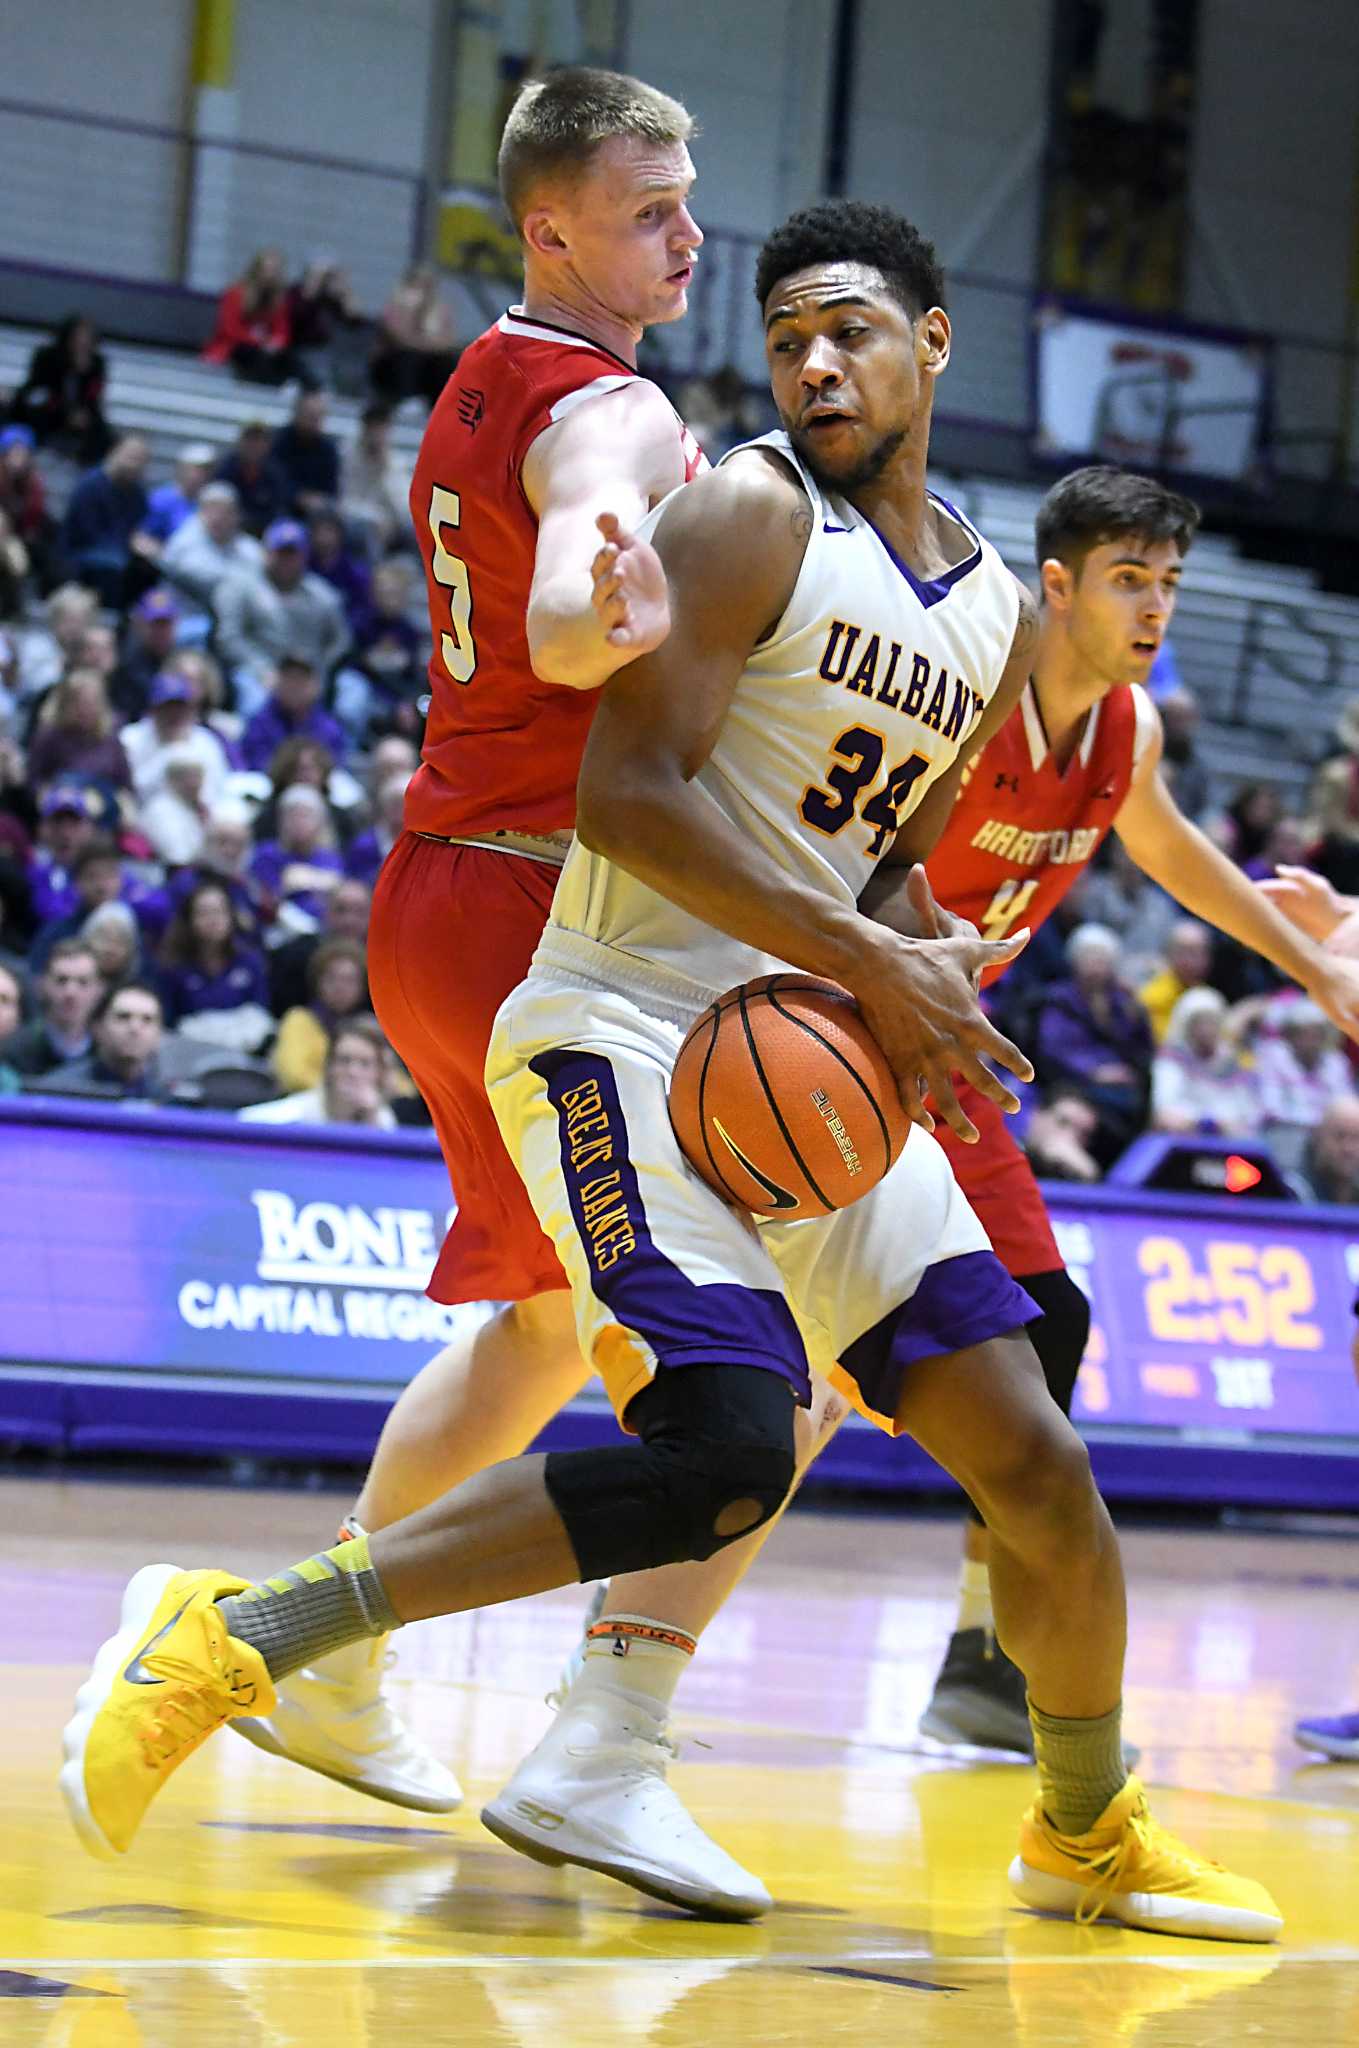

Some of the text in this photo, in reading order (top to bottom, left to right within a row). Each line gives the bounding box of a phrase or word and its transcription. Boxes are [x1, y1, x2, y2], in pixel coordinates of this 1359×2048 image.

[429, 482, 478, 684] 5
[799, 722, 932, 861] 34
[980, 878, 1040, 941] 4
[252, 1190, 436, 1269] BONE
[560, 1078, 637, 1272] GREAT DANES
[178, 1280, 343, 1337] CAPITAL
[1138, 1236, 1325, 1351] 2:52
